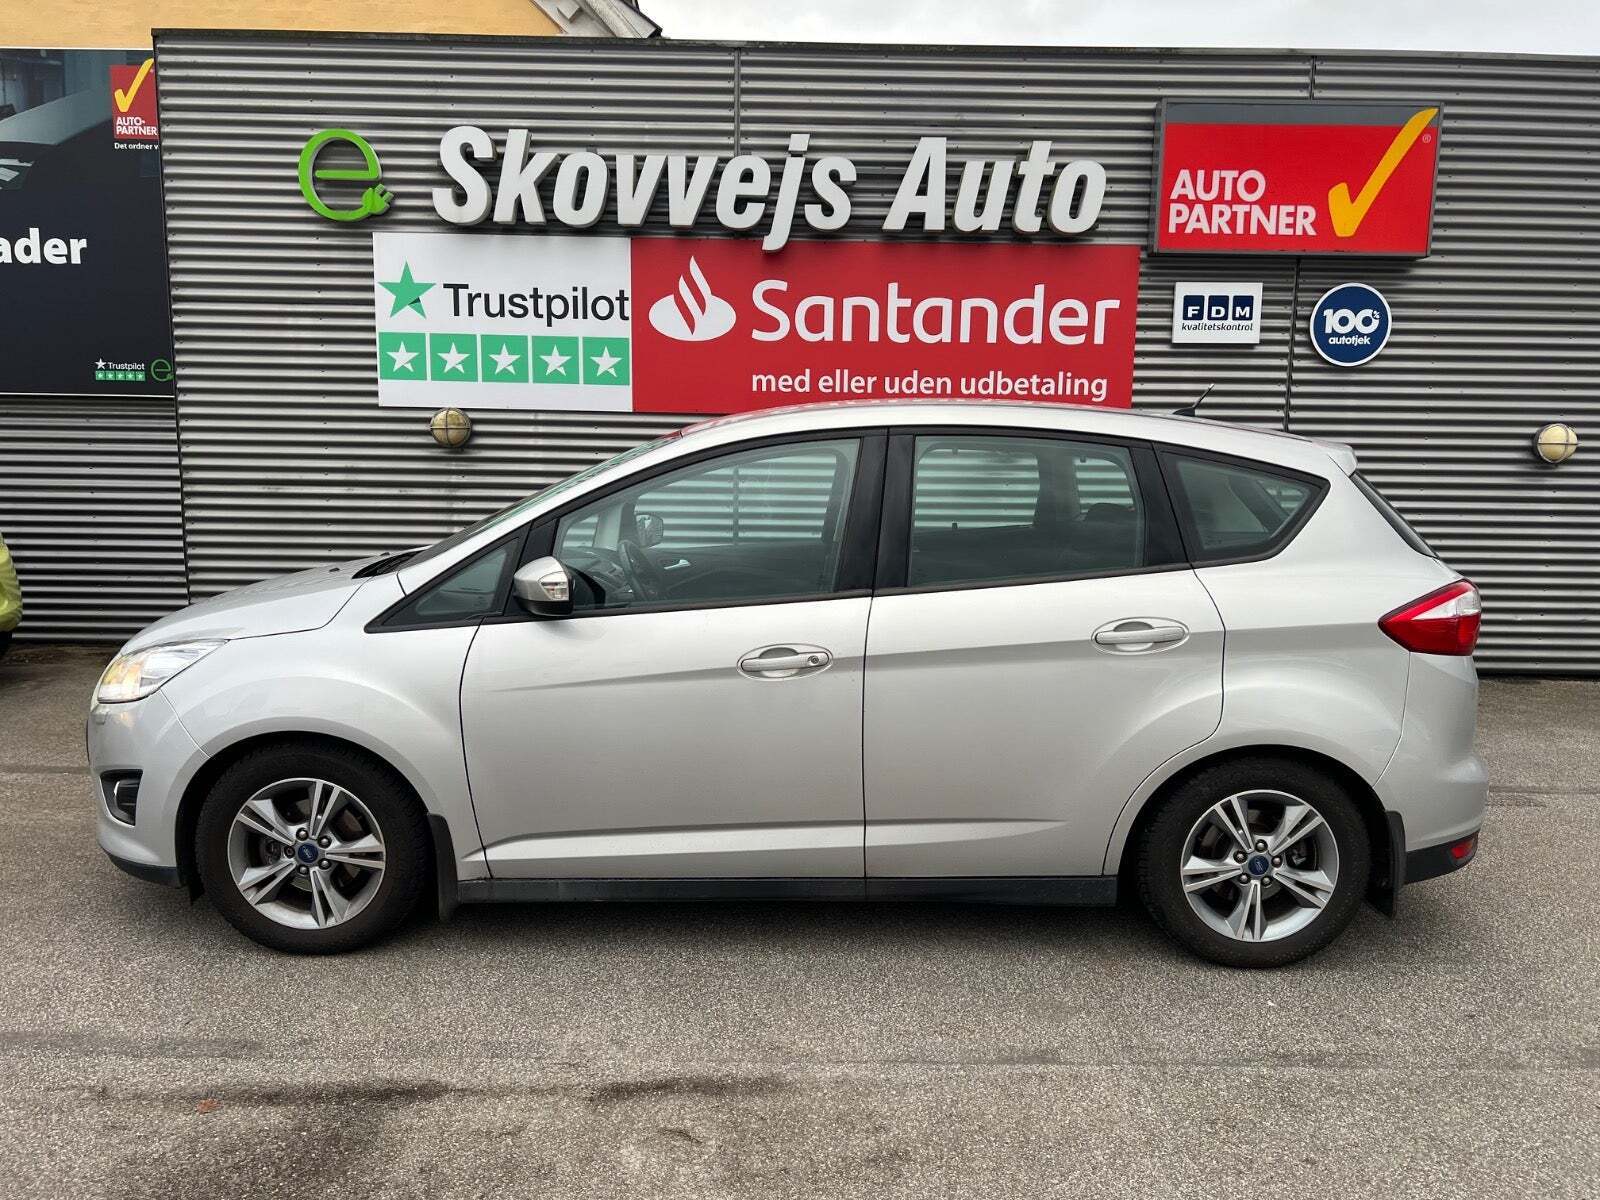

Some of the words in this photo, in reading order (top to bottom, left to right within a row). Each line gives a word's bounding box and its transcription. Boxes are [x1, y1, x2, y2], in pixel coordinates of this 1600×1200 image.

[116, 117, 145, 126] AUTO-
[116, 126, 157, 135] PARTNER
[114, 142, 128, 150] Det
[128, 142, 153, 150] ordner
[432, 125, 858, 252] Skovvejs
[882, 136, 1108, 235] Auto
[1170, 168, 1266, 202] AUTO
[1168, 203, 1318, 236] PARTNER
[443, 282, 630, 327] Trustpilot
[751, 279, 1121, 345] Santander
[1187, 306, 1250, 318] FDM
[1181, 322, 1254, 331] kvalitetskontrol
[1328, 335, 1371, 346] autotjek
[108, 362, 145, 370] Trustpilot
[751, 369, 808, 393] med
[817, 369, 876, 394] eller
[883, 370, 952, 395] uden
[960, 370, 1108, 401] udbetaling
